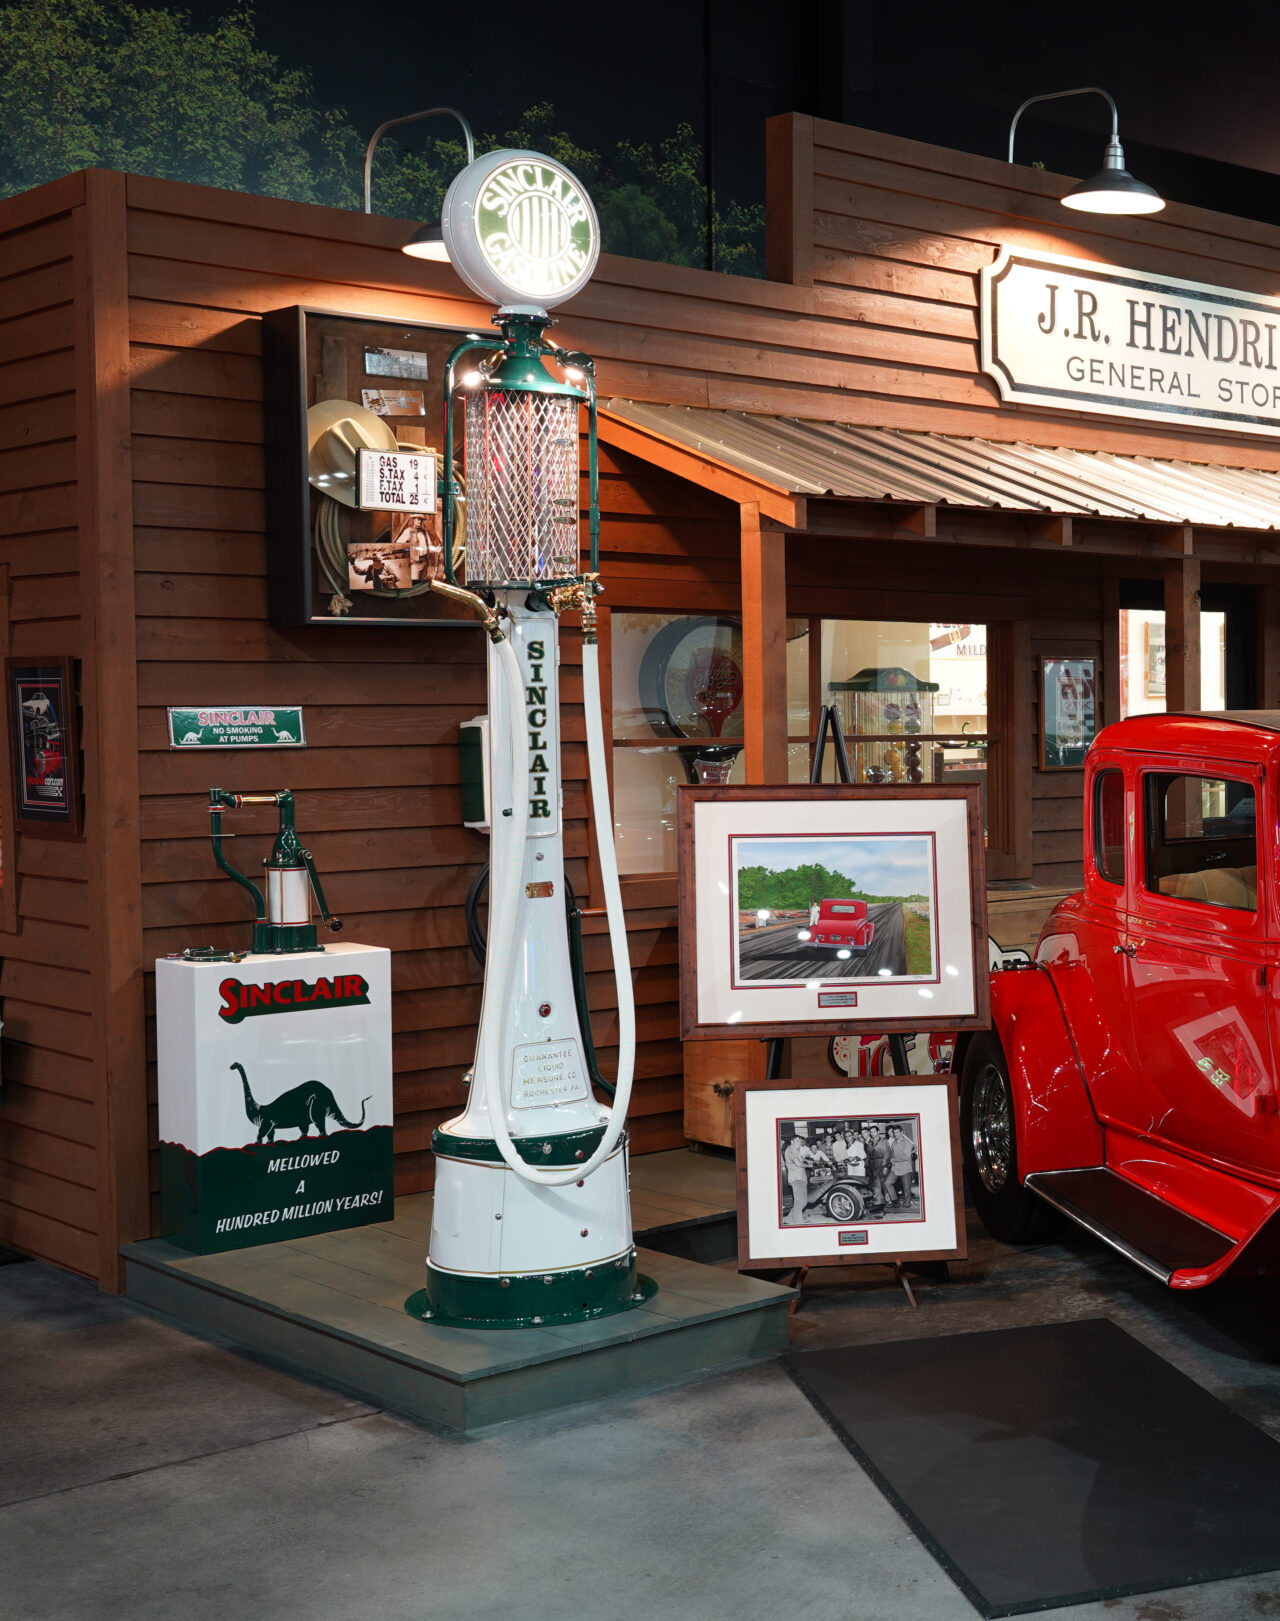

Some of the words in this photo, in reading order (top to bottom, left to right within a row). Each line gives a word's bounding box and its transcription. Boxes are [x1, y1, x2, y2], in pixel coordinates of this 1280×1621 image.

[482, 165, 587, 226] SINCLAIR
[1037, 284, 1111, 346] J.R.
[1066, 355, 1201, 399] GENERAL
[379, 456, 398, 468] GAS
[409, 459, 419, 470] 19
[379, 468, 405, 480] S.TAX
[379, 480, 404, 492] F.TAX
[379, 492, 406, 504] TOTAL
[409, 494, 419, 505] 25
[957, 644, 987, 657] MILD
[198, 711, 277, 726] SINCLAIR
[526, 640, 551, 818] SINCLAIR
[218, 975, 365, 1018] SINCLAIR
[267, 1150, 340, 1173] MELLOWED
[295, 1180, 305, 1194] A
[216, 1209, 280, 1234] HUNDRED
[281, 1199, 334, 1222] MILLION
[335, 1190, 383, 1211] YEARS!
